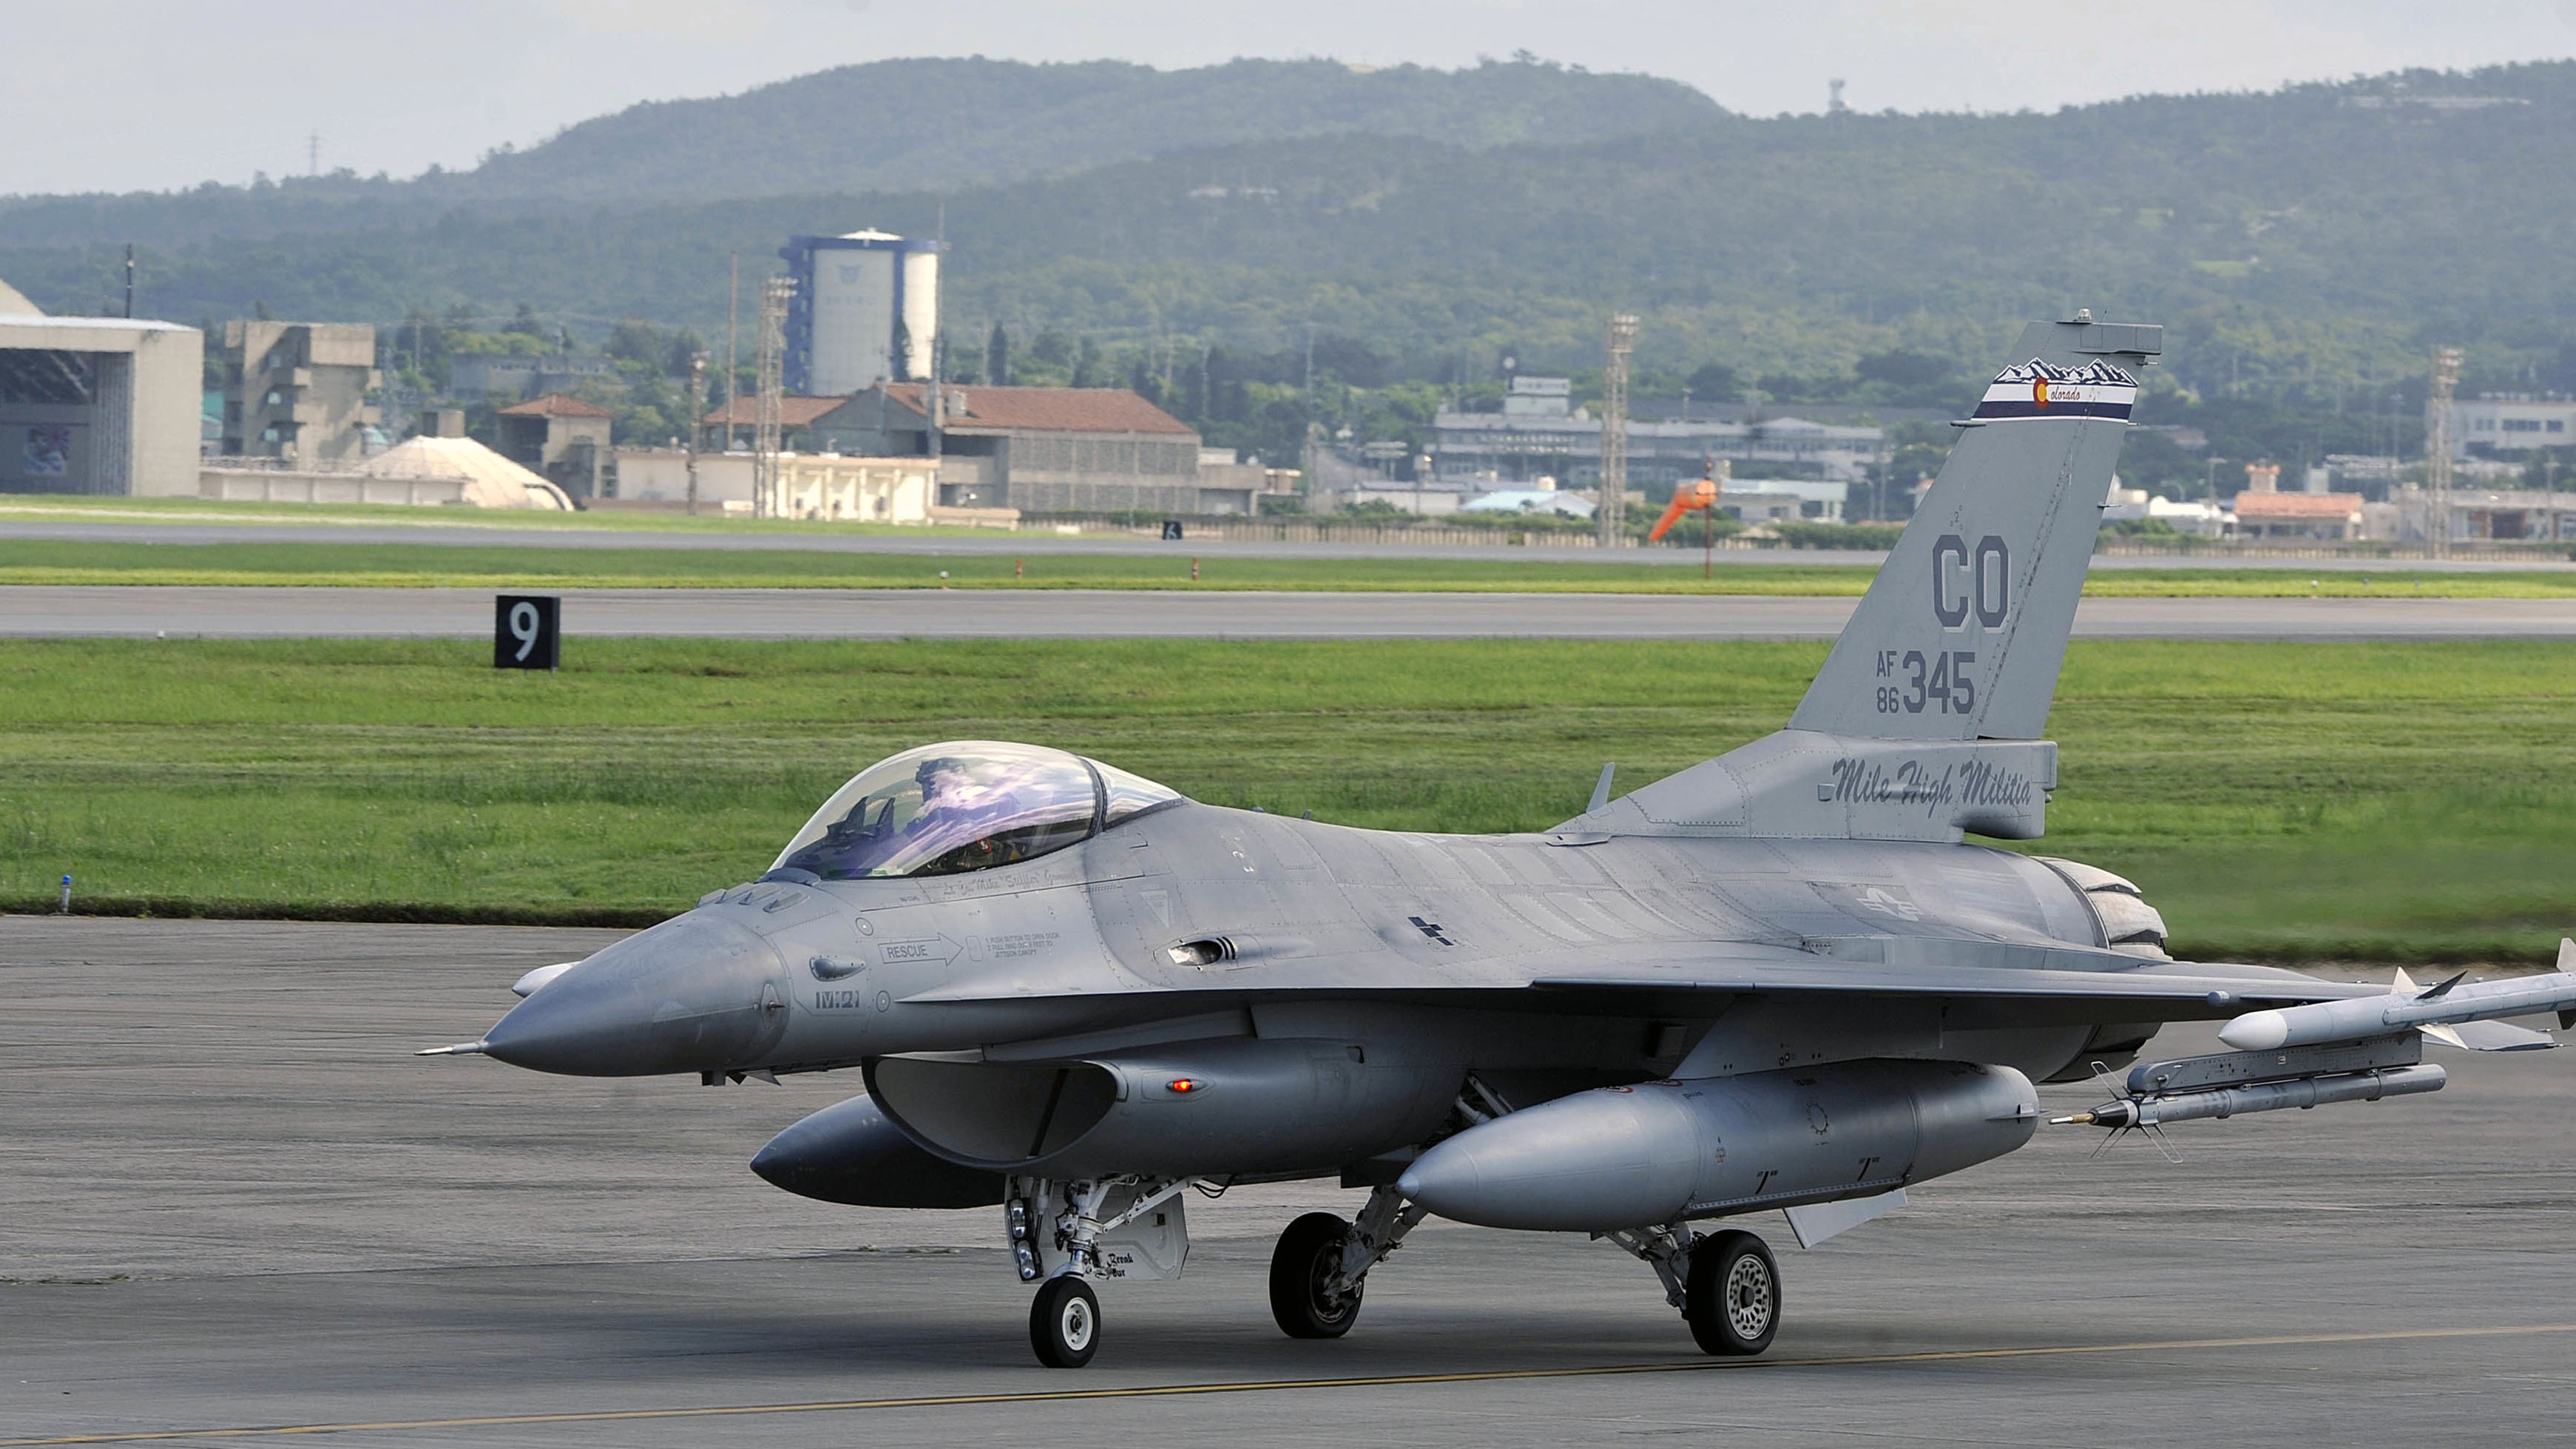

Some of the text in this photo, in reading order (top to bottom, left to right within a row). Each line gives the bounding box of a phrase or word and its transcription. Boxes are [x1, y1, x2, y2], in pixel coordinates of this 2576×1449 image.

[1932, 534, 2011, 633] CO
[509, 601, 539, 662] 9
[1876, 650, 1898, 678] AF
[1902, 650, 1976, 715] 345
[1876, 686, 1899, 714] 86
[1832, 757, 2032, 819] Mile High Militia
[887, 944, 929, 959] RESCUE
